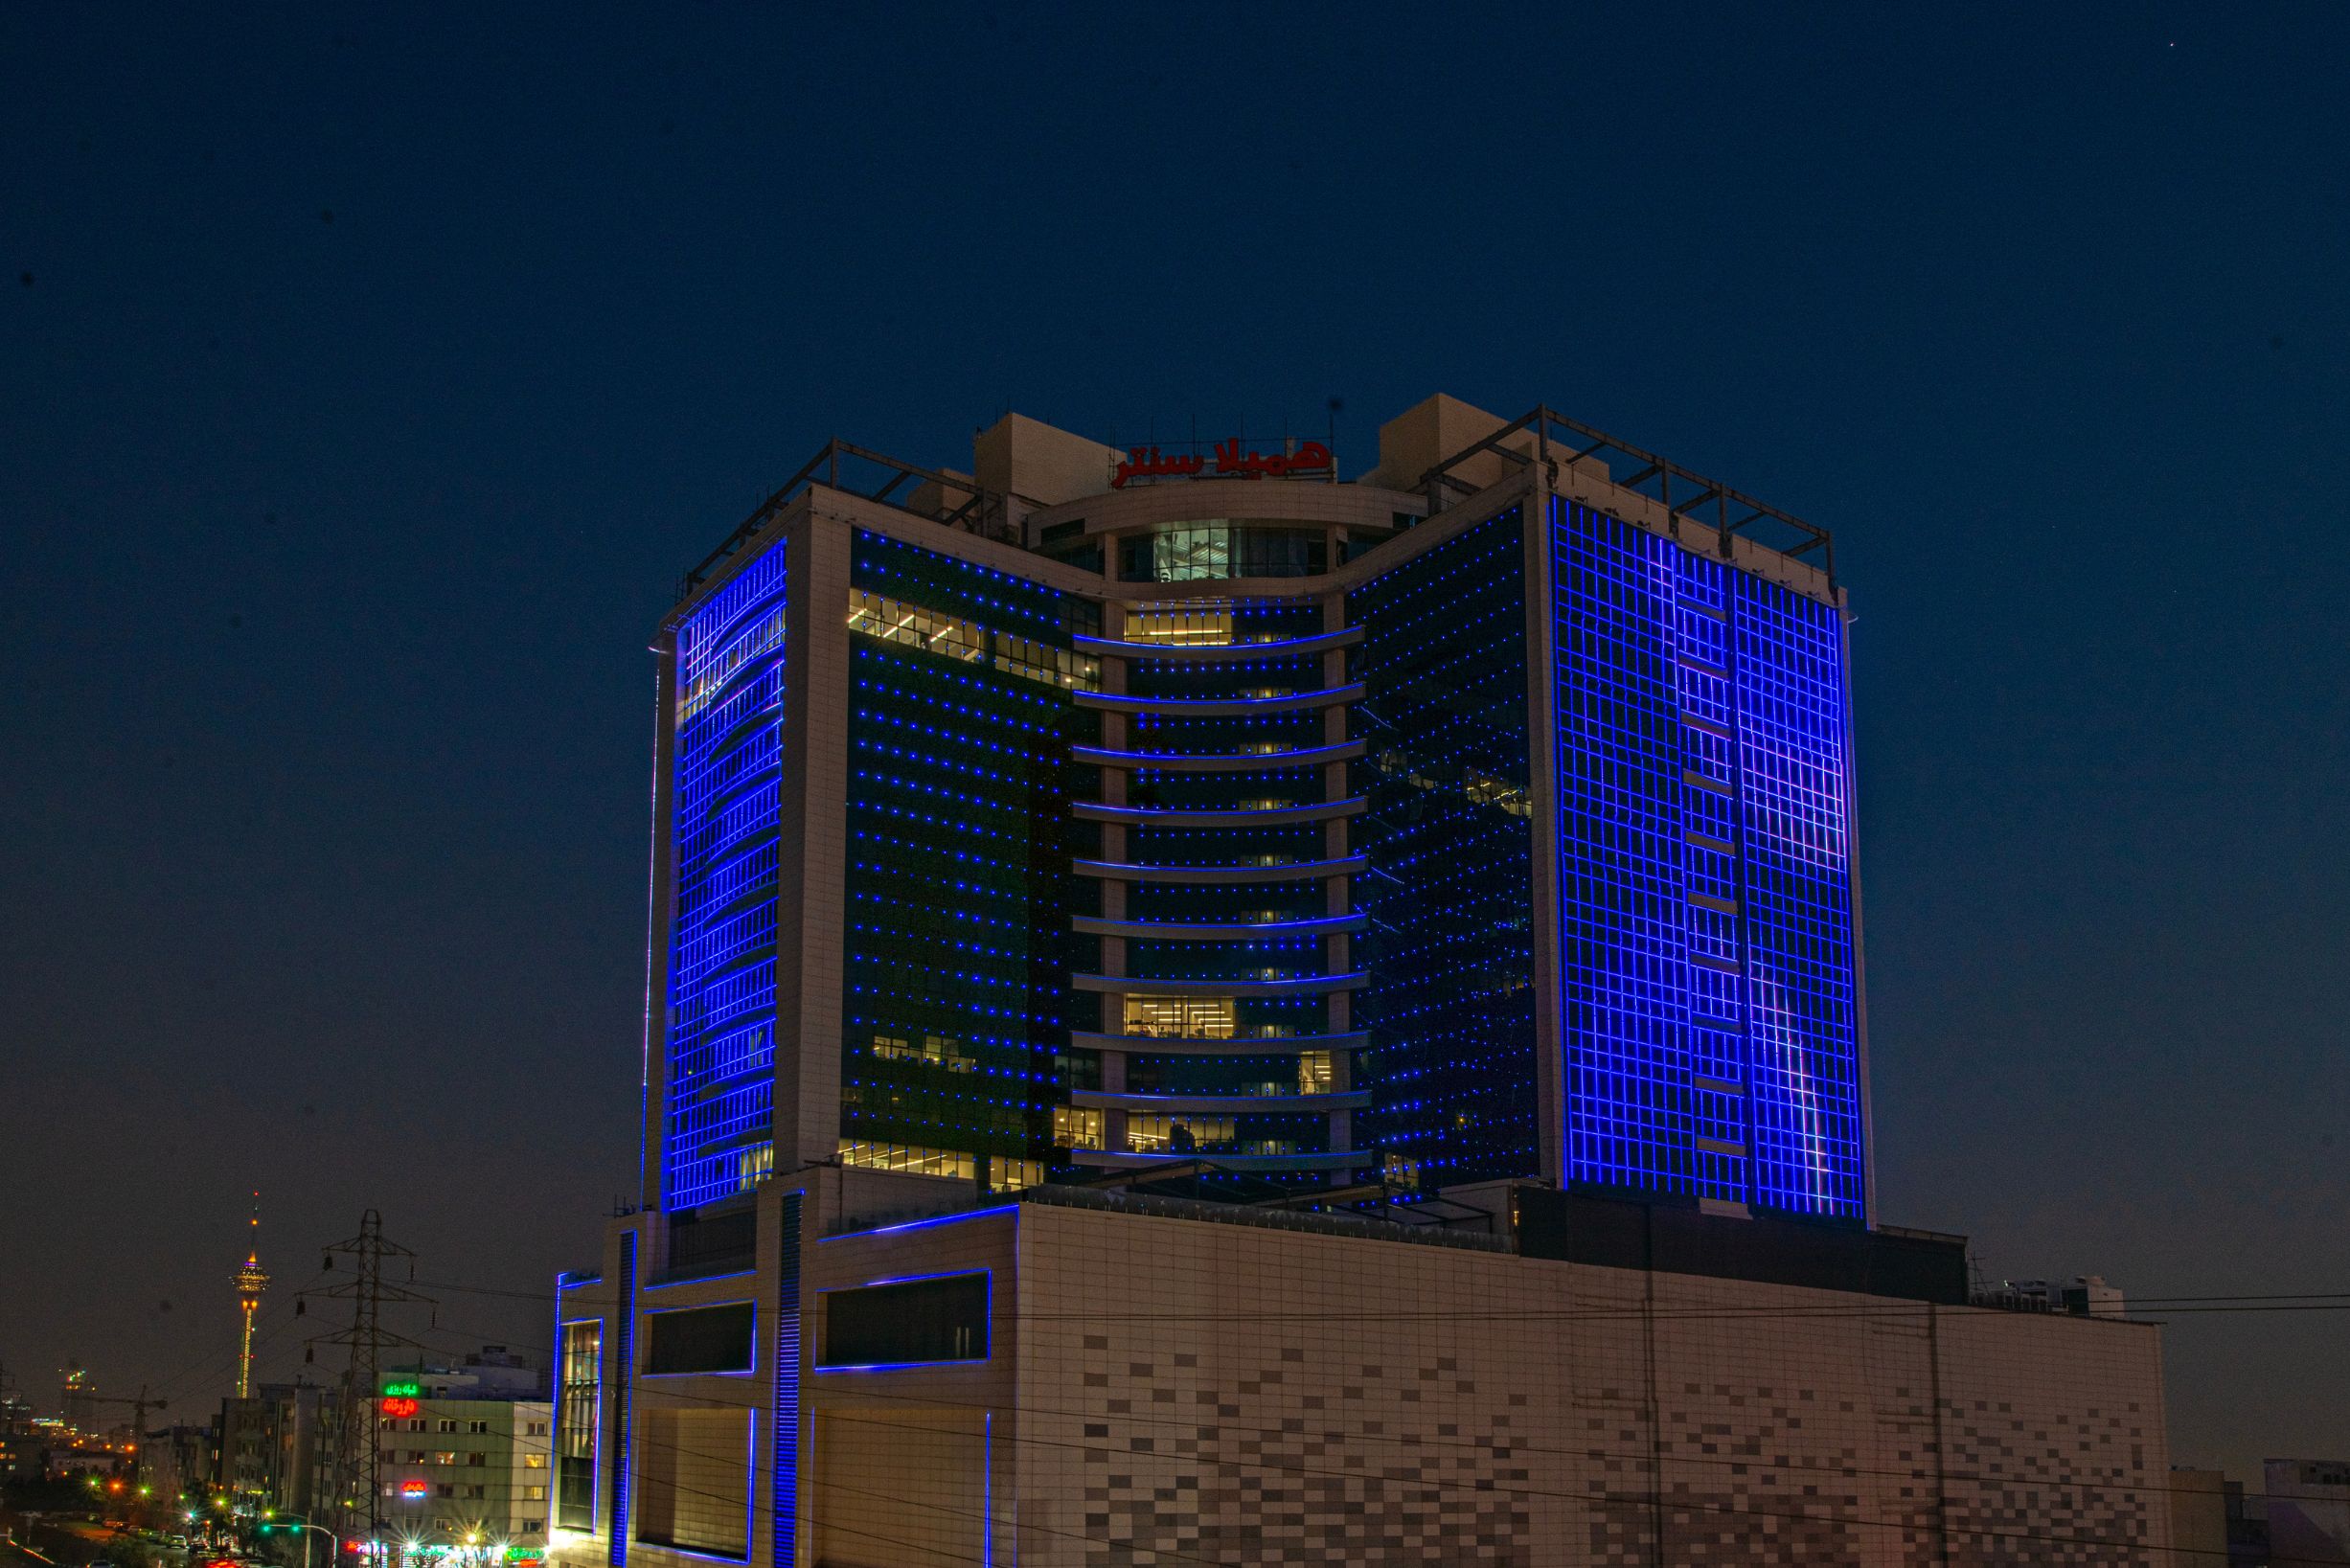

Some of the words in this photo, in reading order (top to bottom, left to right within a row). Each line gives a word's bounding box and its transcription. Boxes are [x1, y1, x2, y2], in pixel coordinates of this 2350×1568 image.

[1111, 446, 1203, 489] سنتر
[386, 1384, 401, 1396] روزی
[401, 1384, 417, 1396] شبانه
[383, 1398, 415, 1416] داروخانه
